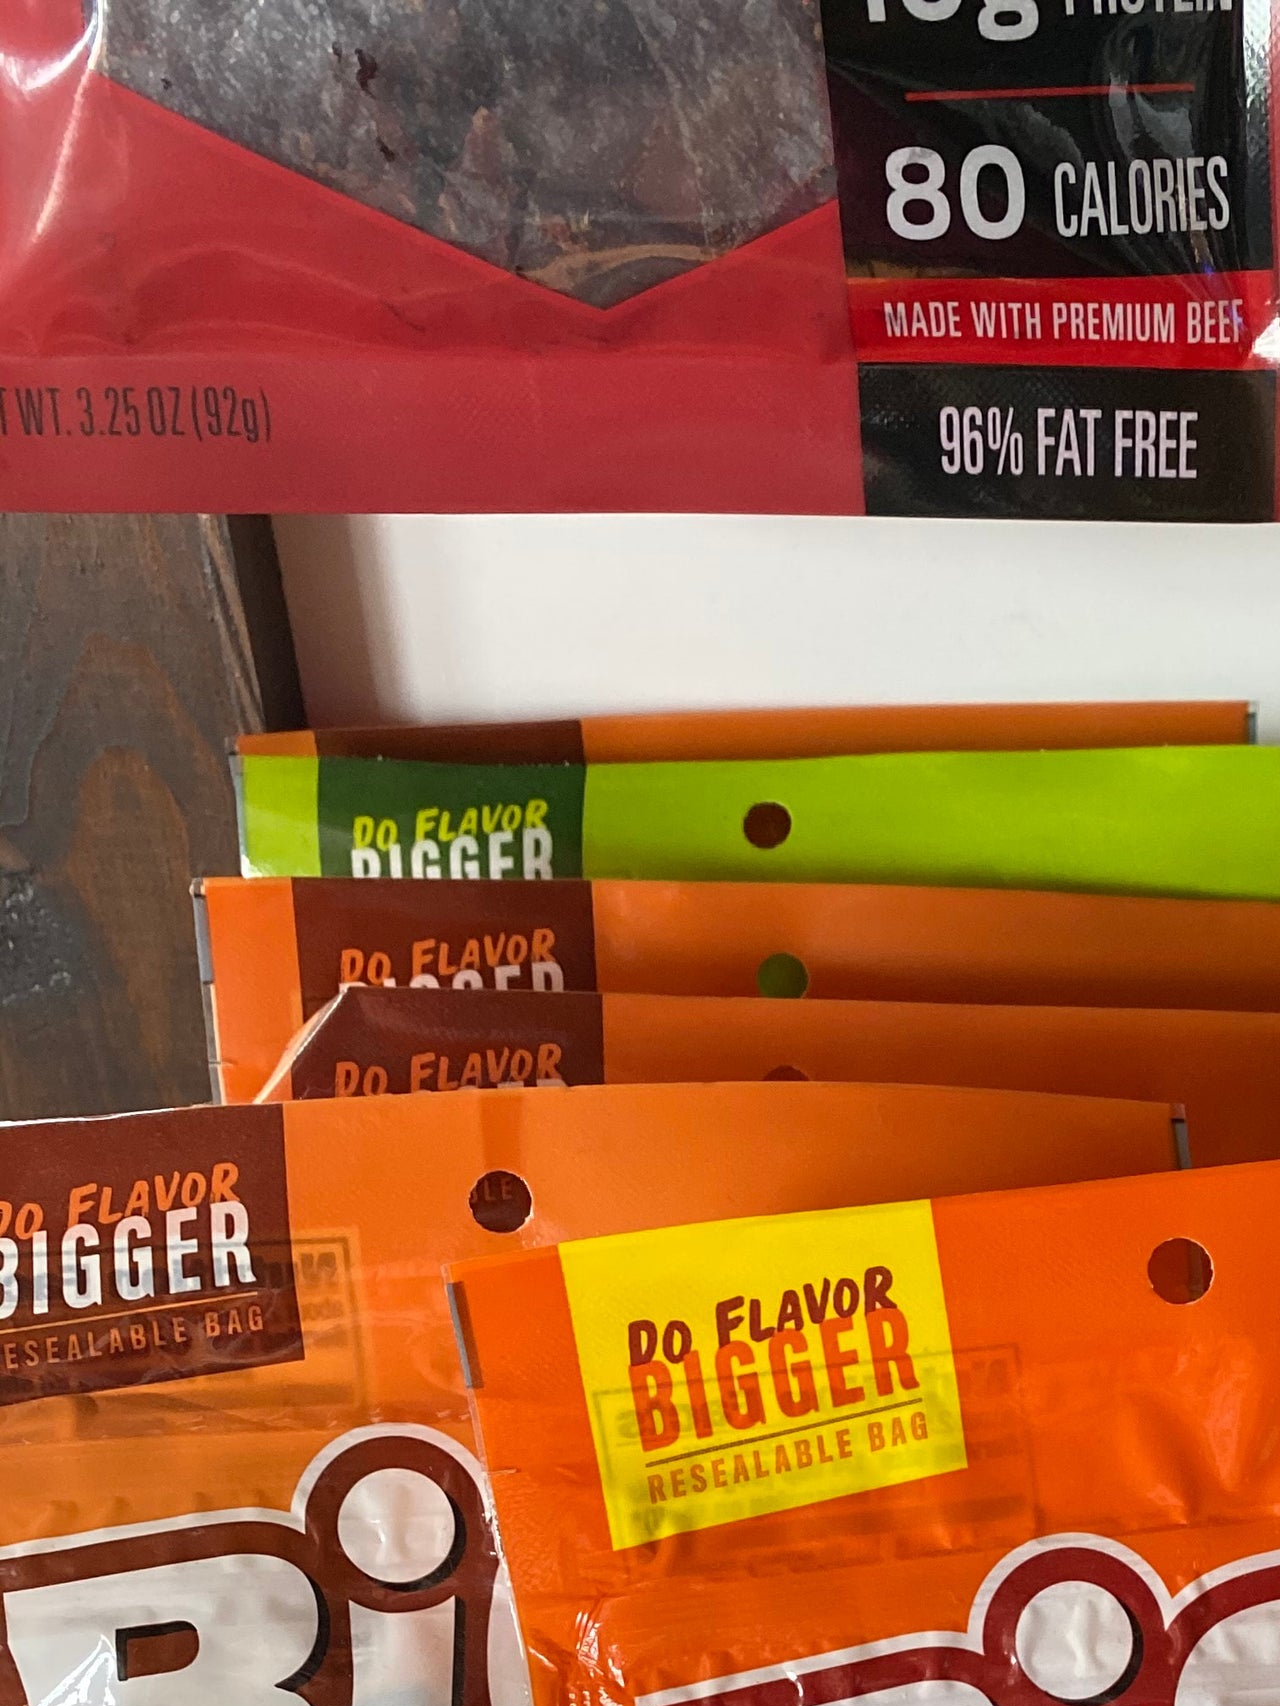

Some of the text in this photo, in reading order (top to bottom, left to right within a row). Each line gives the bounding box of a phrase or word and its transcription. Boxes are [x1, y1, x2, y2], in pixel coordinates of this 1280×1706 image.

[886, 145, 1230, 240] 80 CALORIES
[884, 299, 1242, 343] MADE WITH PREMIUM BEEF
[15, 386, 71, 436] WT.
[77, 386, 141, 436] 3.25
[147, 386, 185, 436] OZ
[192, 385, 271, 443] (92g)
[940, 405, 1198, 478] 96% FAT FREE
[353, 799, 548, 851] DO FLAVOR
[340, 949, 391, 986] DO
[412, 928, 557, 976] FLAVOR
[335, 1043, 562, 1098] DO FLAVOR
[68, 1162, 240, 1228] FLAVOR
[2, 1305, 264, 1370] ESEALABLE BAG
[628, 1265, 897, 1366] DO FLAVOR
[628, 1307, 919, 1452] BIGGER
[647, 1411, 929, 1504] RESEALABLE BAG
